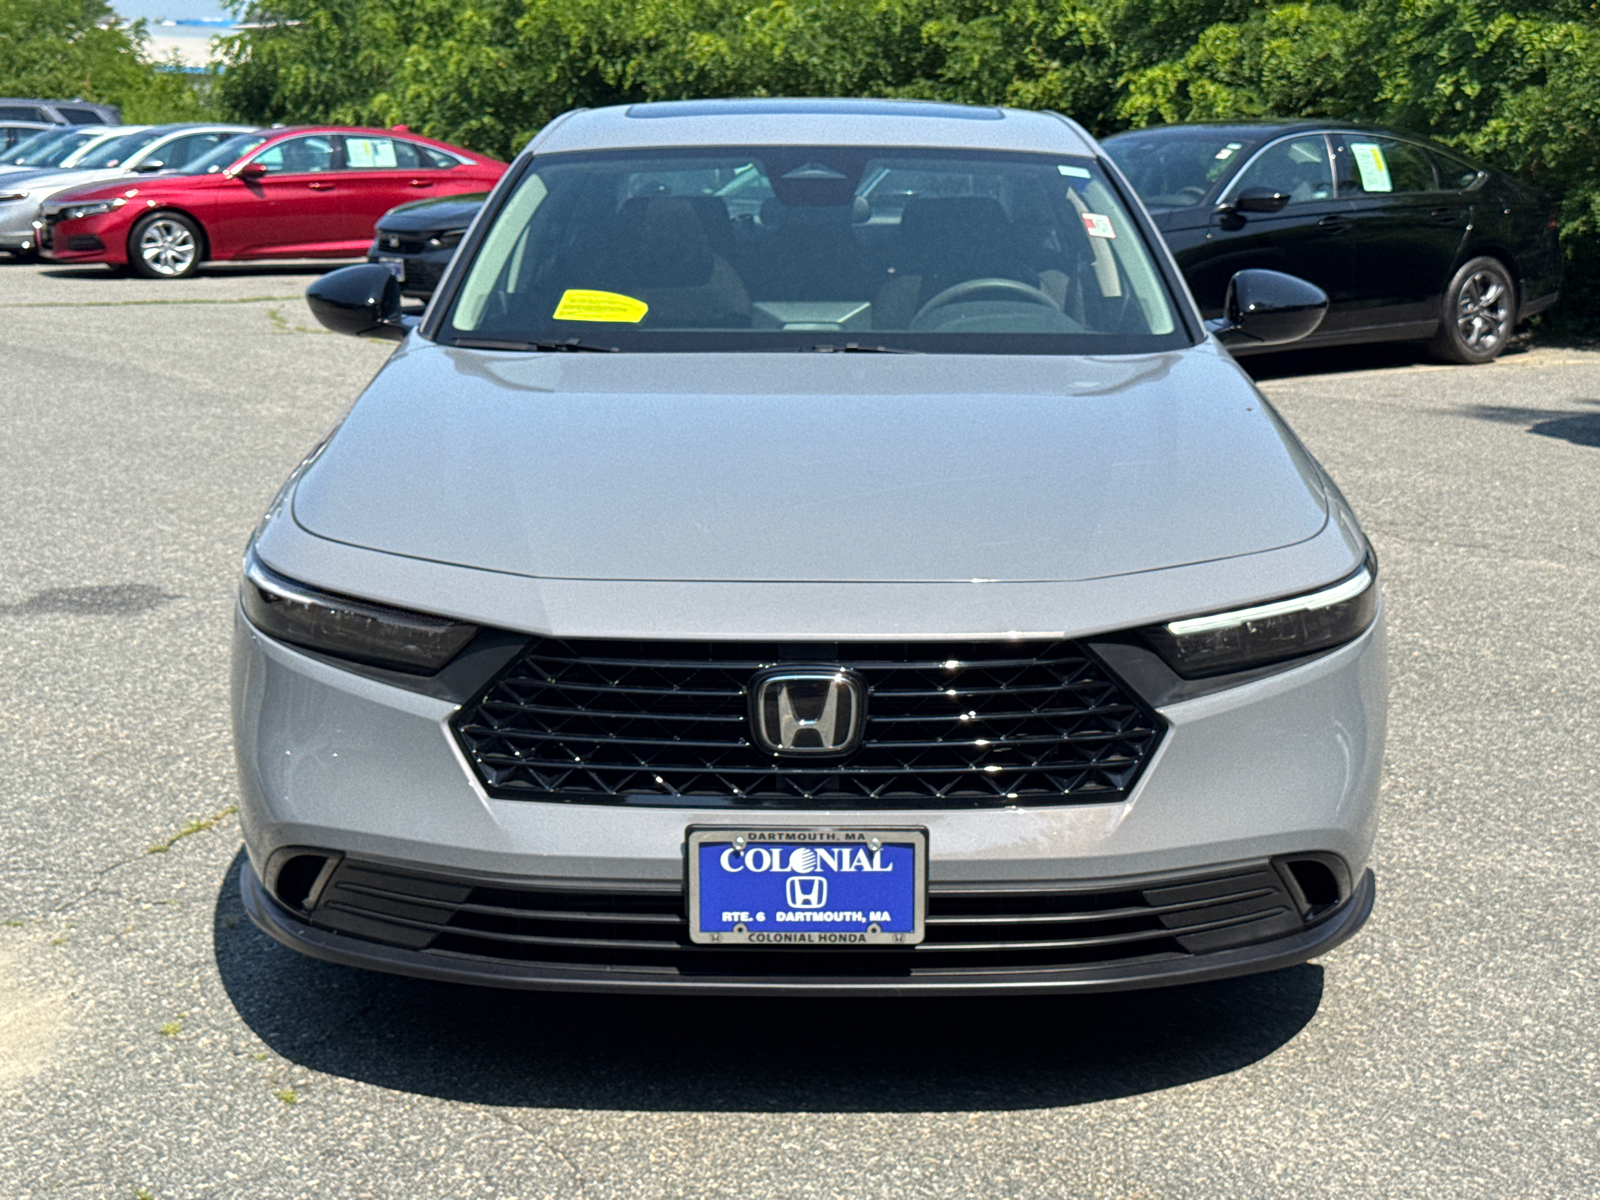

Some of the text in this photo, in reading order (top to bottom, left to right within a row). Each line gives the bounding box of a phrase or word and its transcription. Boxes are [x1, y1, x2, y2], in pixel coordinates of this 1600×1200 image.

[844, 832, 866, 841] MA
[720, 847, 893, 874] COLONIAL
[721, 911, 891, 923] RTE. 6 DARTMOUTH, MA
[748, 933, 867, 943] COLONIAL HONDA
